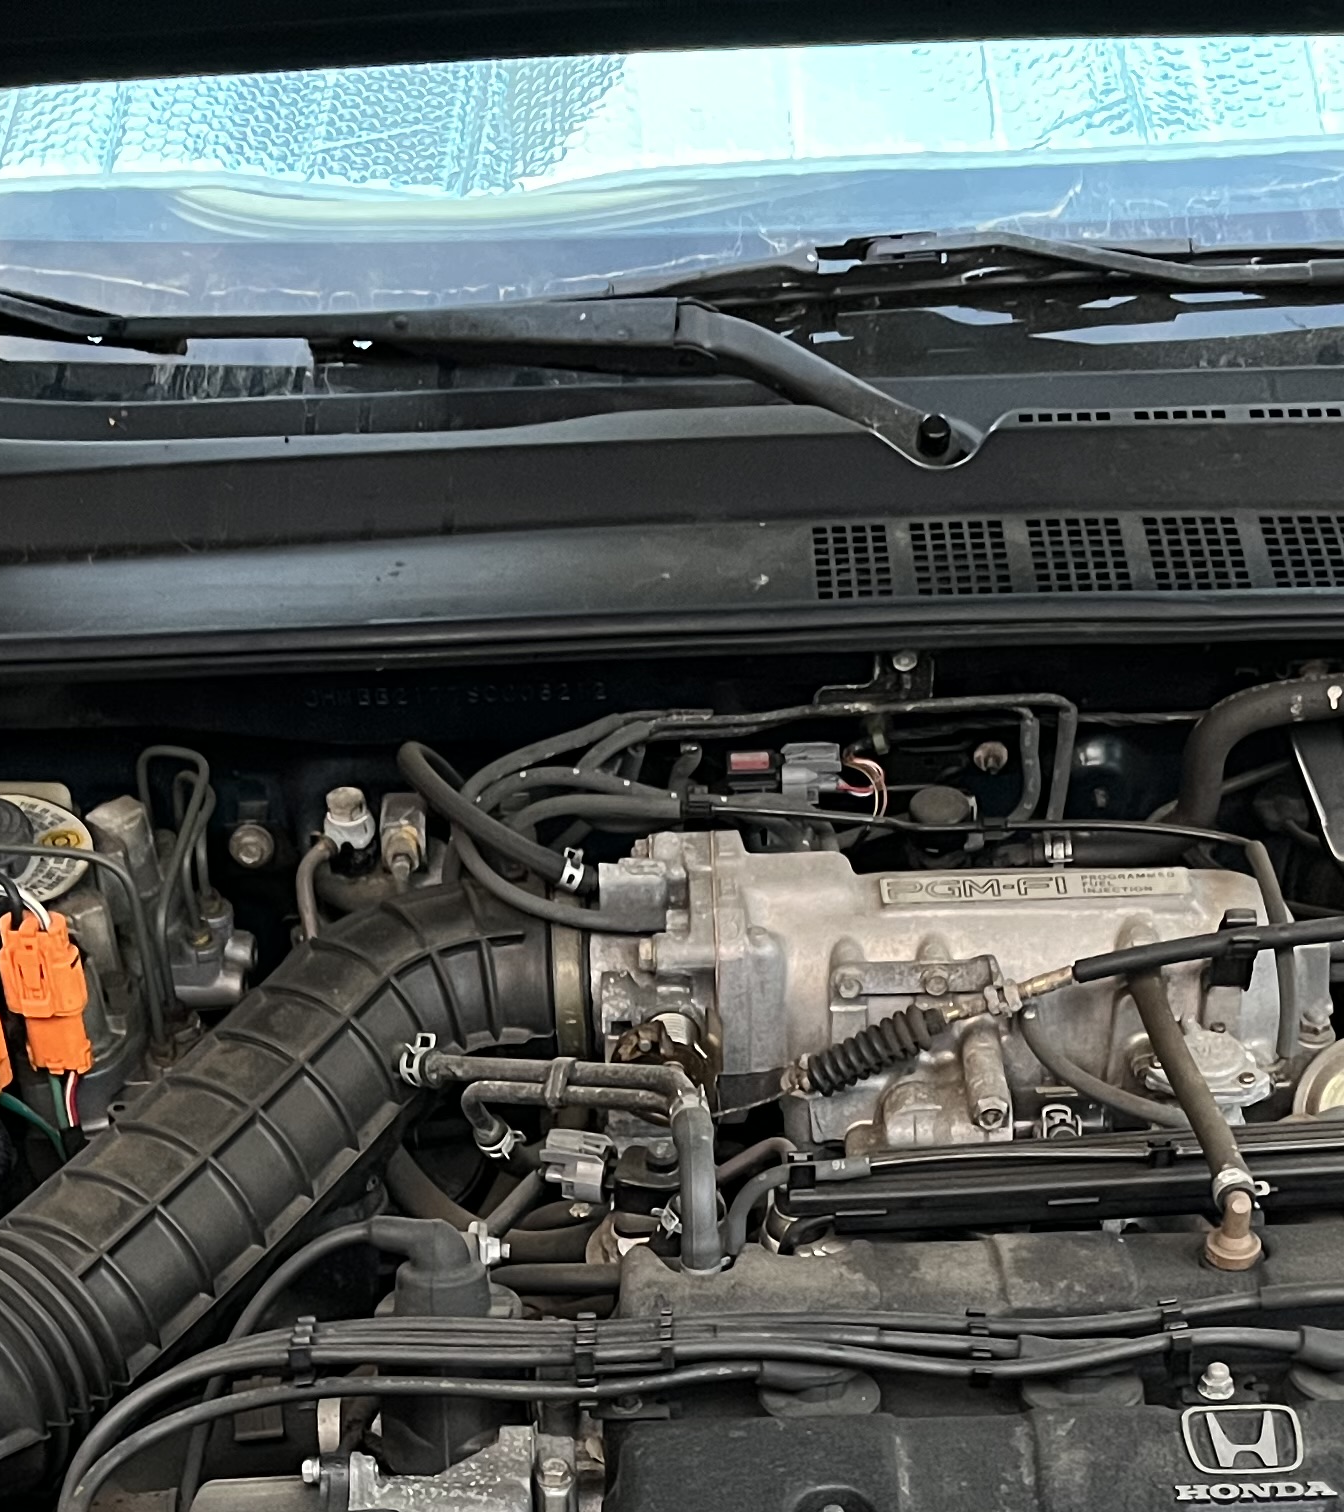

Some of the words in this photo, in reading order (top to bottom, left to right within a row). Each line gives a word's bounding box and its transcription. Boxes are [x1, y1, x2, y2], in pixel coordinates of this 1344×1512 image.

[1080, 872, 1175, 882] PROGRAMMED
[886, 876, 1068, 900] PGM-FI
[1081, 880, 1114, 889] FUEL
[1082, 885, 1154, 894] INJECTION
[1174, 1480, 1339, 1502] HONDA
